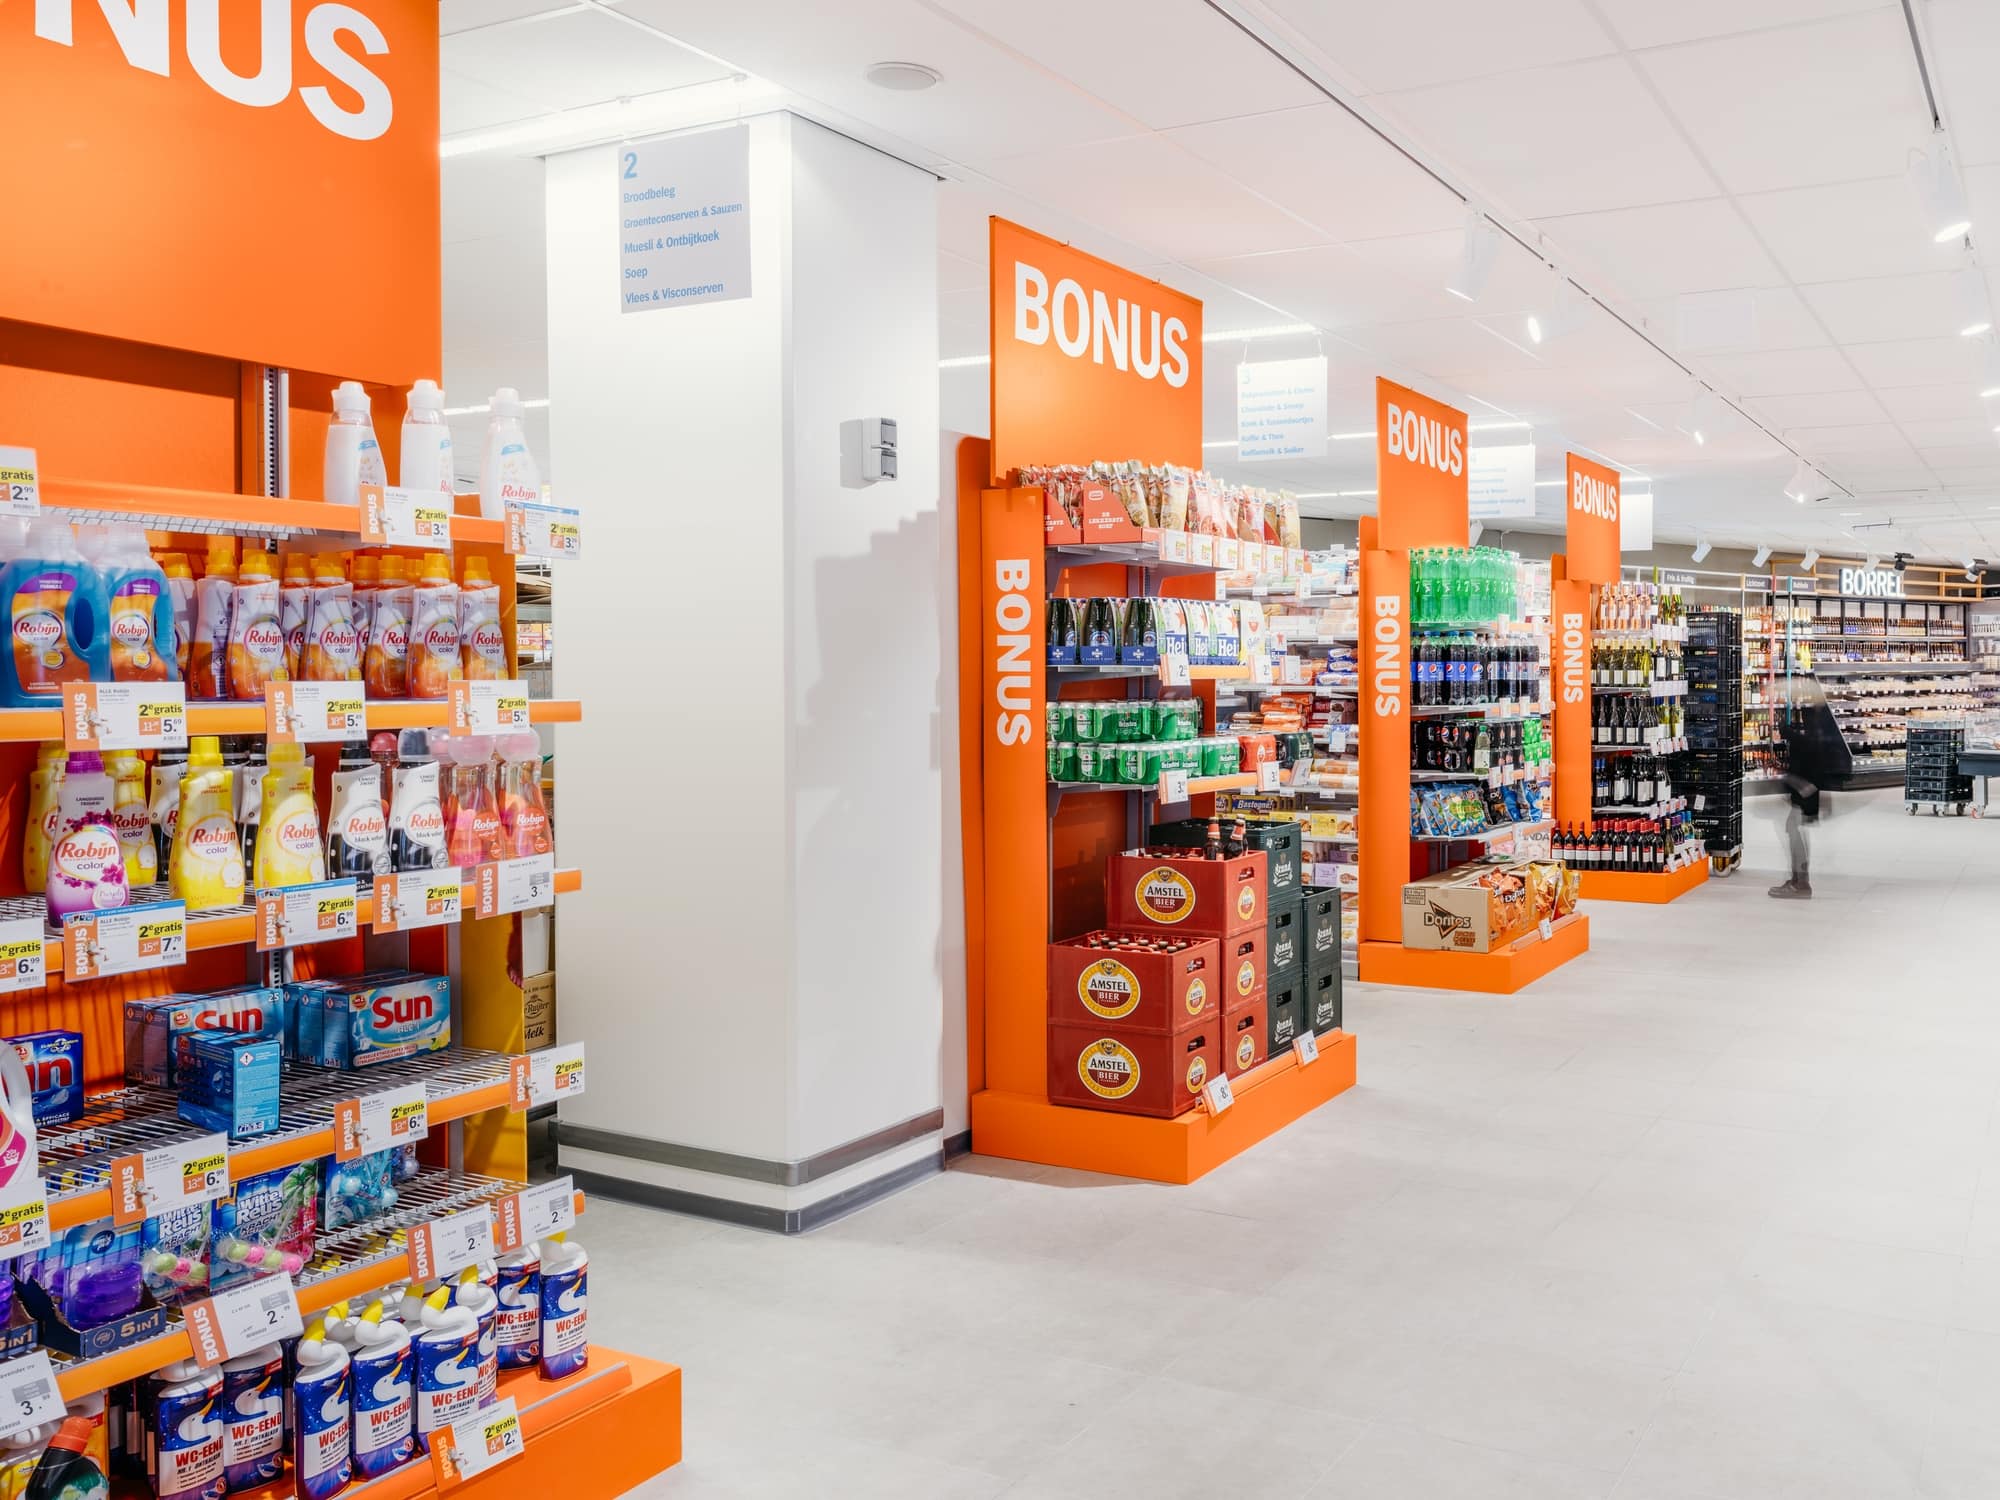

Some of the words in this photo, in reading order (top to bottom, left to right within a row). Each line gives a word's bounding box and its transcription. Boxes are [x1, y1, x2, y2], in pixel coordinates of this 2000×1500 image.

[624, 152, 637, 179] 2
[624, 186, 676, 203] Broodbeleg
[624, 209, 699, 228] Groenteconserven
[701, 207, 708, 216] &
[710, 203, 742, 215] Sauzen
[624, 239, 653, 254] Muesli
[656, 239, 663, 249] &
[666, 229, 719, 247] Ontbijtkoek
[625, 267, 648, 279] Soep
[626, 291, 650, 304] Vlees
[652, 291, 659, 301] &
[662, 282, 724, 299] Visconserven
[1015, 260, 1188, 388] BONUS
[1387, 403, 1462, 477] BONUS
[1, 471, 34, 480] gratis
[12, 486, 34, 501] 2.99
[501, 484, 536, 499] Robijn
[1573, 471, 1617, 522] BONUS
[368, 494, 379, 534] BONUS
[415, 509, 425, 519] 2e
[426, 511, 447, 519] gratis
[511, 514, 519, 551] BONUS
[560, 526, 578, 534] gratis
[1841, 568, 1905, 597] BORREL
[19, 621, 59, 635] Robijn
[116, 623, 147, 636] Robijn
[249, 630, 282, 646] Robijn
[387, 631, 409, 645] Rob
[260, 645, 277, 653] color
[996, 559, 1031, 746] BONUS
[1375, 595, 1400, 717] BONUS
[1563, 613, 1583, 703] BONUS
[139, 704, 153, 716] 2e
[154, 704, 183, 715] gratis
[327, 701, 339, 712] 2e
[340, 701, 363, 711] gratis
[455, 689, 465, 727] BONUS
[507, 699, 526, 708] gratis
[74, 693, 88, 740] BONUS
[274, 691, 287, 734] BONUS
[113, 814, 149, 828] Robijn
[473, 818, 499, 829] Robijn
[517, 813, 545, 824] Robijn
[123, 830, 143, 838] color
[192, 827, 236, 844] Robijn
[61, 841, 116, 859] Robijn
[206, 846, 228, 855] color
[296, 842, 314, 850] color
[77, 862, 104, 870] color
[427, 888, 437, 899] 2e
[437, 886, 459, 897] gratis
[482, 867, 493, 913] BONUS
[1147, 886, 1184, 897] AMSTEL
[318, 901, 330, 912] 2e
[330, 898, 354, 911] gratis
[381, 883, 390, 923] BONUS
[1155, 898, 1175, 906] BIER
[266, 902, 277, 945] BONUS
[1424, 912, 1471, 928] Doritos
[139, 925, 153, 938] 2e
[153, 923, 183, 935] gratis
[8, 942, 41, 956] gratis
[75, 927, 88, 975] BONUS
[18, 957, 40, 974] 6.99
[437, 981, 447, 990] 25
[1090, 979, 1128, 991] AMSTEL
[268, 993, 280, 1001] 25
[1099, 991, 1120, 1000] BIER
[195, 1008, 262, 1032] Sun
[372, 995, 433, 1029] Sun
[556, 1064, 565, 1074] 2e
[565, 1060, 583, 1072] gratis
[1090, 1058, 1127, 1071] AMSTEL
[516, 1064, 525, 1101] BONUS
[1099, 1071, 1119, 1081] BIER
[391, 1106, 402, 1119] 2e
[402, 1102, 425, 1115] gratis
[343, 1109, 354, 1151] BONUS
[184, 1161, 198, 1176] 2e
[198, 1156, 225, 1171] gratis
[206, 1169, 225, 1186] 6.99
[122, 1166, 136, 1213] BONUS
[238, 1190, 282, 1208] Witte
[12, 1204, 44, 1221] gratis
[236, 1200, 283, 1225] Reus
[22, 1219, 44, 1238] 2.95
[160, 1210, 202, 1240] Reus
[504, 1199, 516, 1246] BONUS
[414, 1228, 429, 1278] BONUS
[193, 1307, 219, 1361] BONUS
[432, 1382, 480, 1408] WC-EEND
[370, 1396, 411, 1427] WC-EEND
[231, 1411, 282, 1440] WC-EEND
[485, 1424, 495, 1439] 2e
[495, 1416, 517, 1434] gratis
[176, 1435, 224, 1467] WC-EEND
[437, 1436, 454, 1479] BONUS
